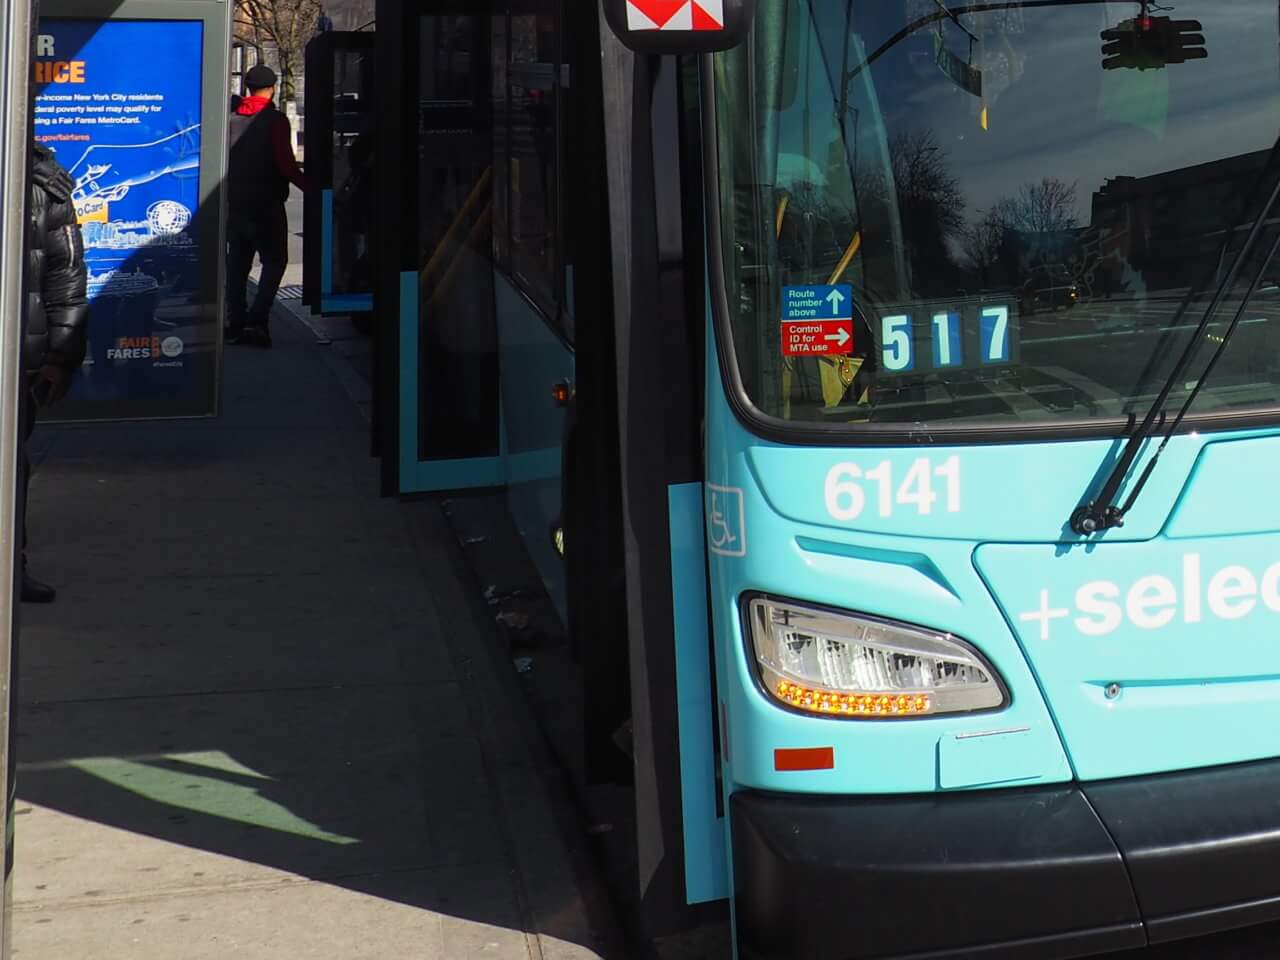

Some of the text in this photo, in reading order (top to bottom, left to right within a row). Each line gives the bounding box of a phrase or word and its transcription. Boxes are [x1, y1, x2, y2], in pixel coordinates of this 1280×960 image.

[111, 93, 128, 102] City
[788, 289, 815, 299] Route
[788, 299, 823, 308] number
[788, 309, 817, 317] above
[789, 325, 823, 334] Control
[789, 334, 816, 343] ID for
[789, 344, 829, 352] MTA use
[106, 347, 151, 360] FARES
[823, 454, 962, 522] 6141
